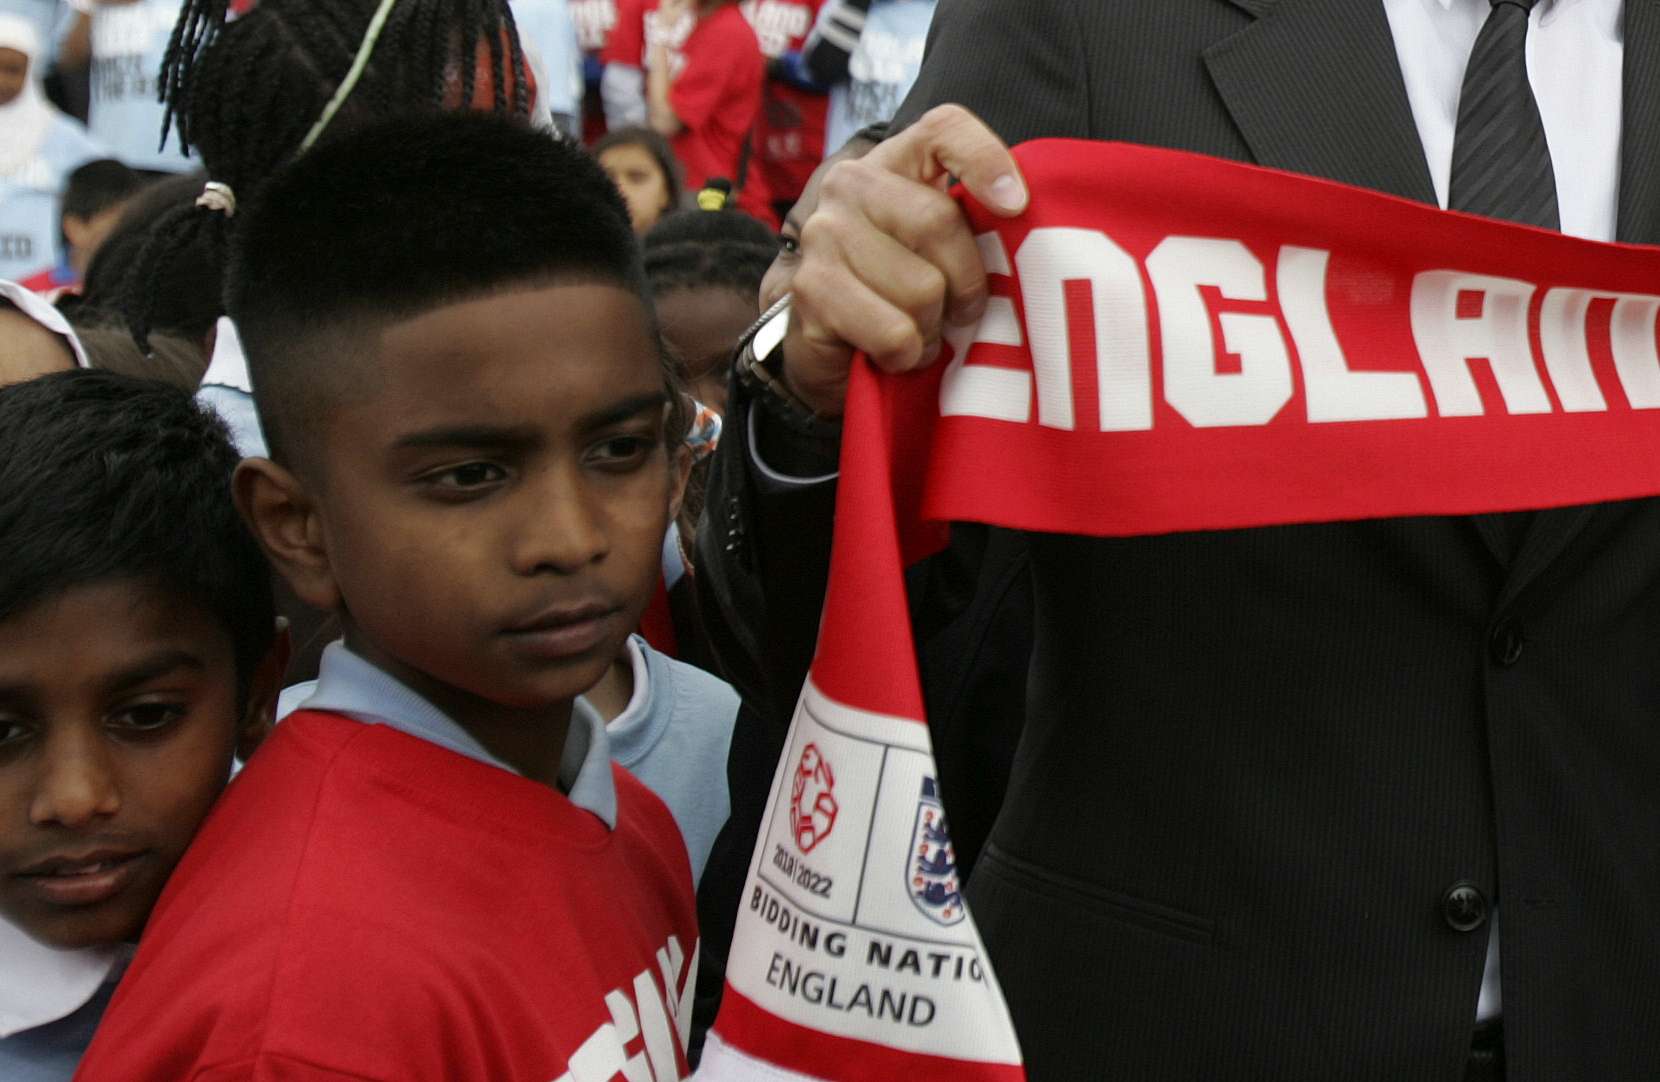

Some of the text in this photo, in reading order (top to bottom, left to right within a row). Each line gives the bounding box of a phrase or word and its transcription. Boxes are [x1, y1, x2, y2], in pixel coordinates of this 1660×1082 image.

[750, 885, 985, 984] BIDDING NATIO
[765, 951, 937, 1028] ENGLAND
